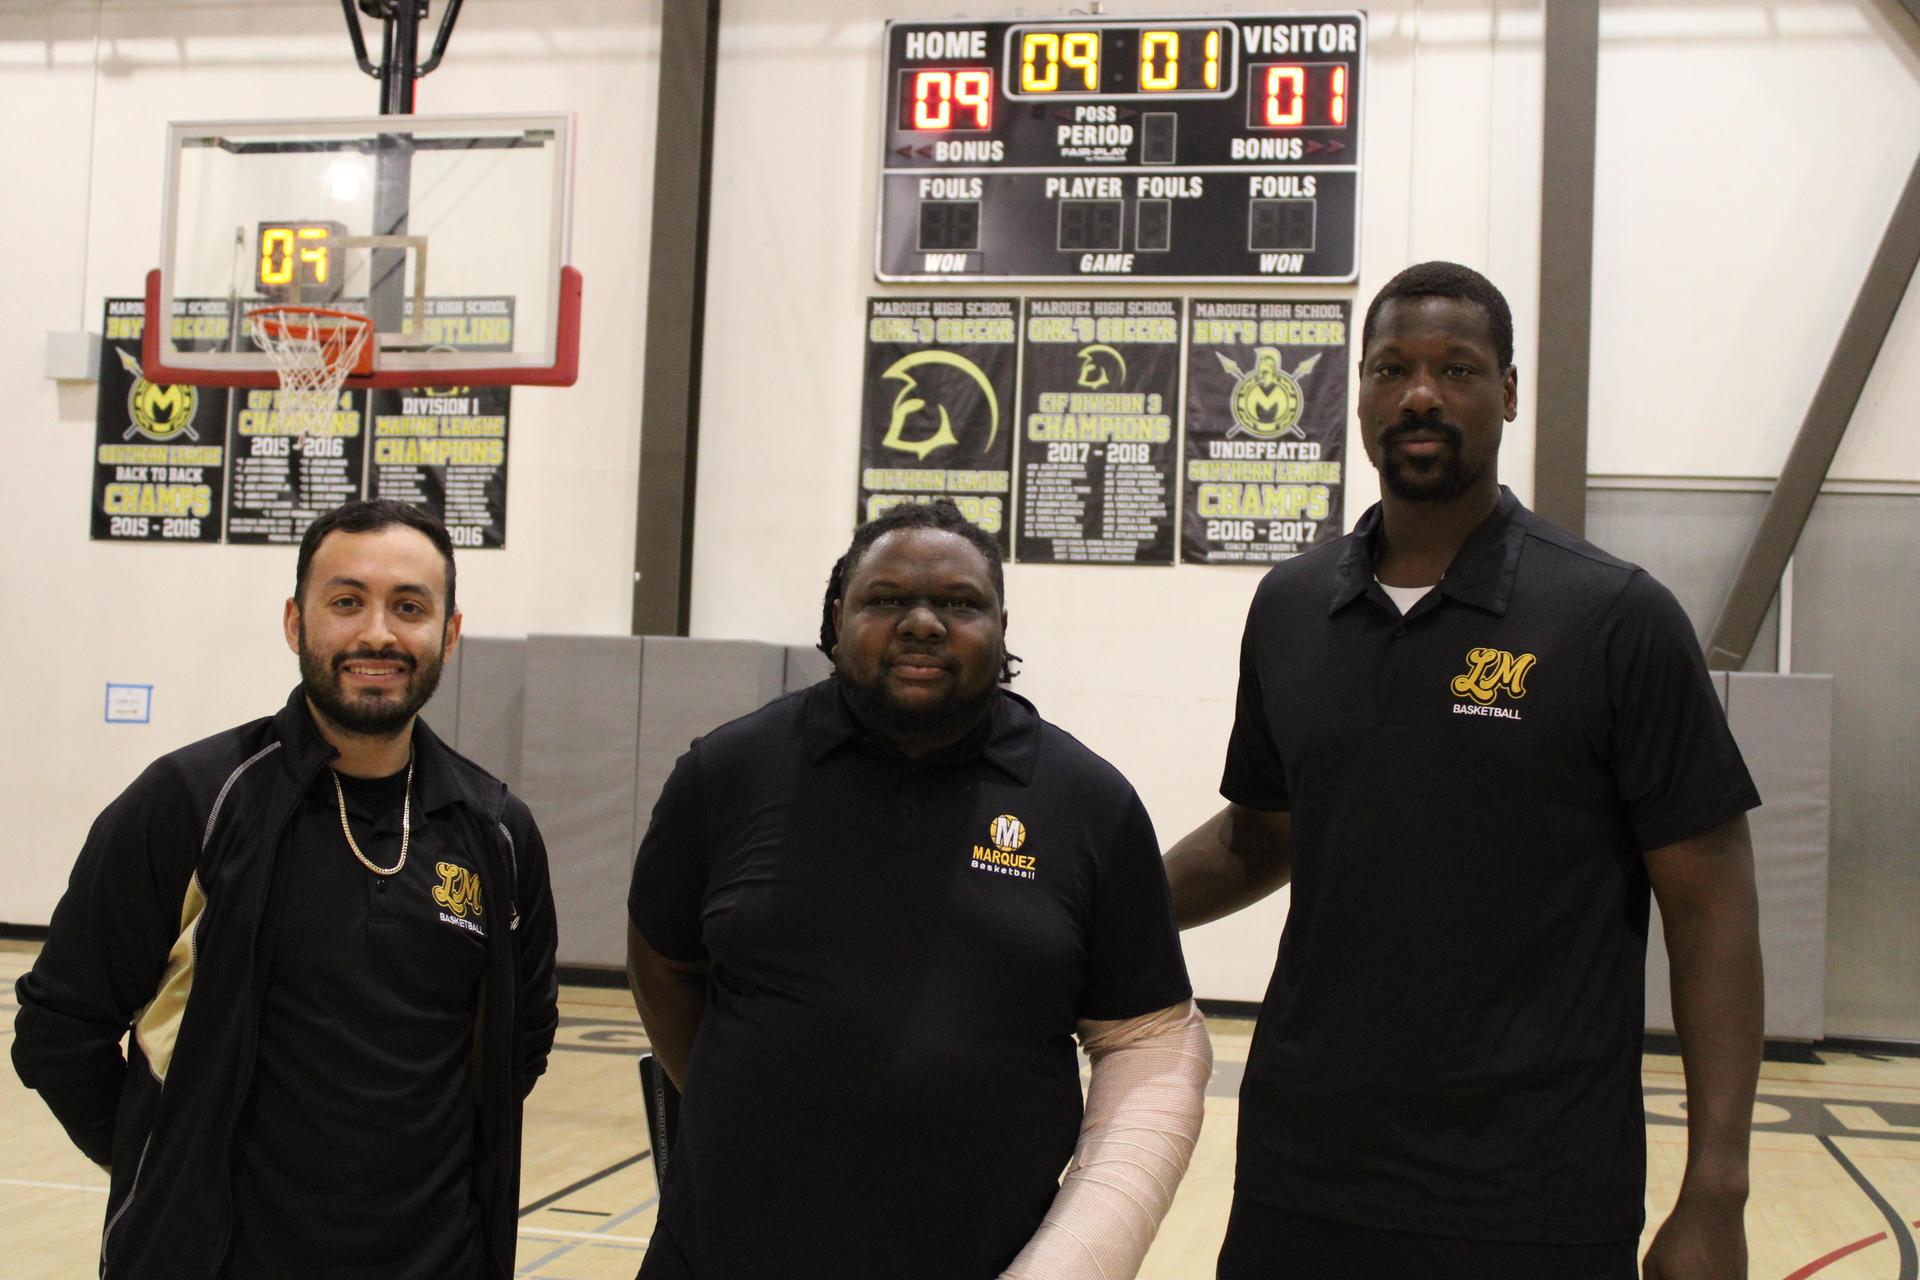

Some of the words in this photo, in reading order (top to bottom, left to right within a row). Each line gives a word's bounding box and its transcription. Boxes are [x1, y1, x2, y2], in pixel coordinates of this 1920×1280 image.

[906, 31, 986, 59] HOME
[1244, 24, 1356, 54] VISITOR
[1021, 31, 1098, 91] 09
[1141, 30, 1218, 91] 01
[915, 70, 990, 129] 09
[1266, 65, 1345, 126] 01
[1075, 105, 1117, 123] POSS
[1057, 125, 1134, 146] PERIOD
[935, 140, 1004, 161] BONUS
[1231, 138, 1302, 160] BONUS
[919, 179, 983, 199] FOULS
[1046, 178, 1122, 199] PLAYER
[1137, 177, 1203, 198] FOULS
[1249, 176, 1316, 197] FOULS
[924, 254, 967, 273] WON
[1079, 254, 1135, 273] GAME
[1259, 254, 1304, 273] WON
[465, 300, 509, 314] SCHOOL
[873, 302, 931, 316] MARQUEZ
[934, 302, 964, 316] HIGH
[966, 302, 1013, 316] SCHOOL
[1031, 302, 1091, 315] MARQUEZ
[1094, 302, 1124, 315] HIGH
[1128, 302, 1175, 315] SCHOOL
[1196, 304, 1257, 318] MARQUEZ
[1260, 304, 1292, 318] HIGH
[1294, 305, 1343, 318] SCHOOL
[107, 317, 144, 338] BOY
[171, 316, 229, 338] OCCER
[402, 316, 511, 344] RSTLING
[936, 318, 1014, 343] SOCCER
[1097, 318, 1177, 343] SOCCER
[1260, 321, 1345, 345] SOCCER
[403, 398, 469, 414] DIVISION
[1070, 393, 1145, 413] DIVISION
[375, 416, 439, 436] MARINE
[441, 416, 505, 437] LEAGUE
[1028, 413, 1171, 443] CHAMPIONS
[251, 437, 289, 456] 2015
[303, 437, 344, 457] 2016
[375, 438, 504, 465] CHAMPIONS
[1047, 443, 1090, 463] 2017
[1106, 443, 1150, 463] 2018
[1209, 441, 1321, 460] UNDEFEATED
[116, 467, 149, 482] BACK
[151, 468, 167, 482] TO
[169, 468, 202, 482] BACK
[1276, 462, 1340, 484] LEAGUE
[103, 483, 211, 517] CHAMPS
[1199, 483, 1330, 519] CHAMPS
[867, 494, 1002, 533] CPS
[110, 517, 148, 536] 2015
[163, 519, 200, 537] 2016
[1207, 521, 1255, 541] 2016
[1269, 521, 1317, 543] 2017
[1453, 704, 1522, 720] BASKETBALL
[996, 816, 1020, 849] M
[972, 845, 1036, 871] MARQUEZ
[971, 860, 1035, 880] Basketball
[440, 912, 485, 936] BASKETBALL
